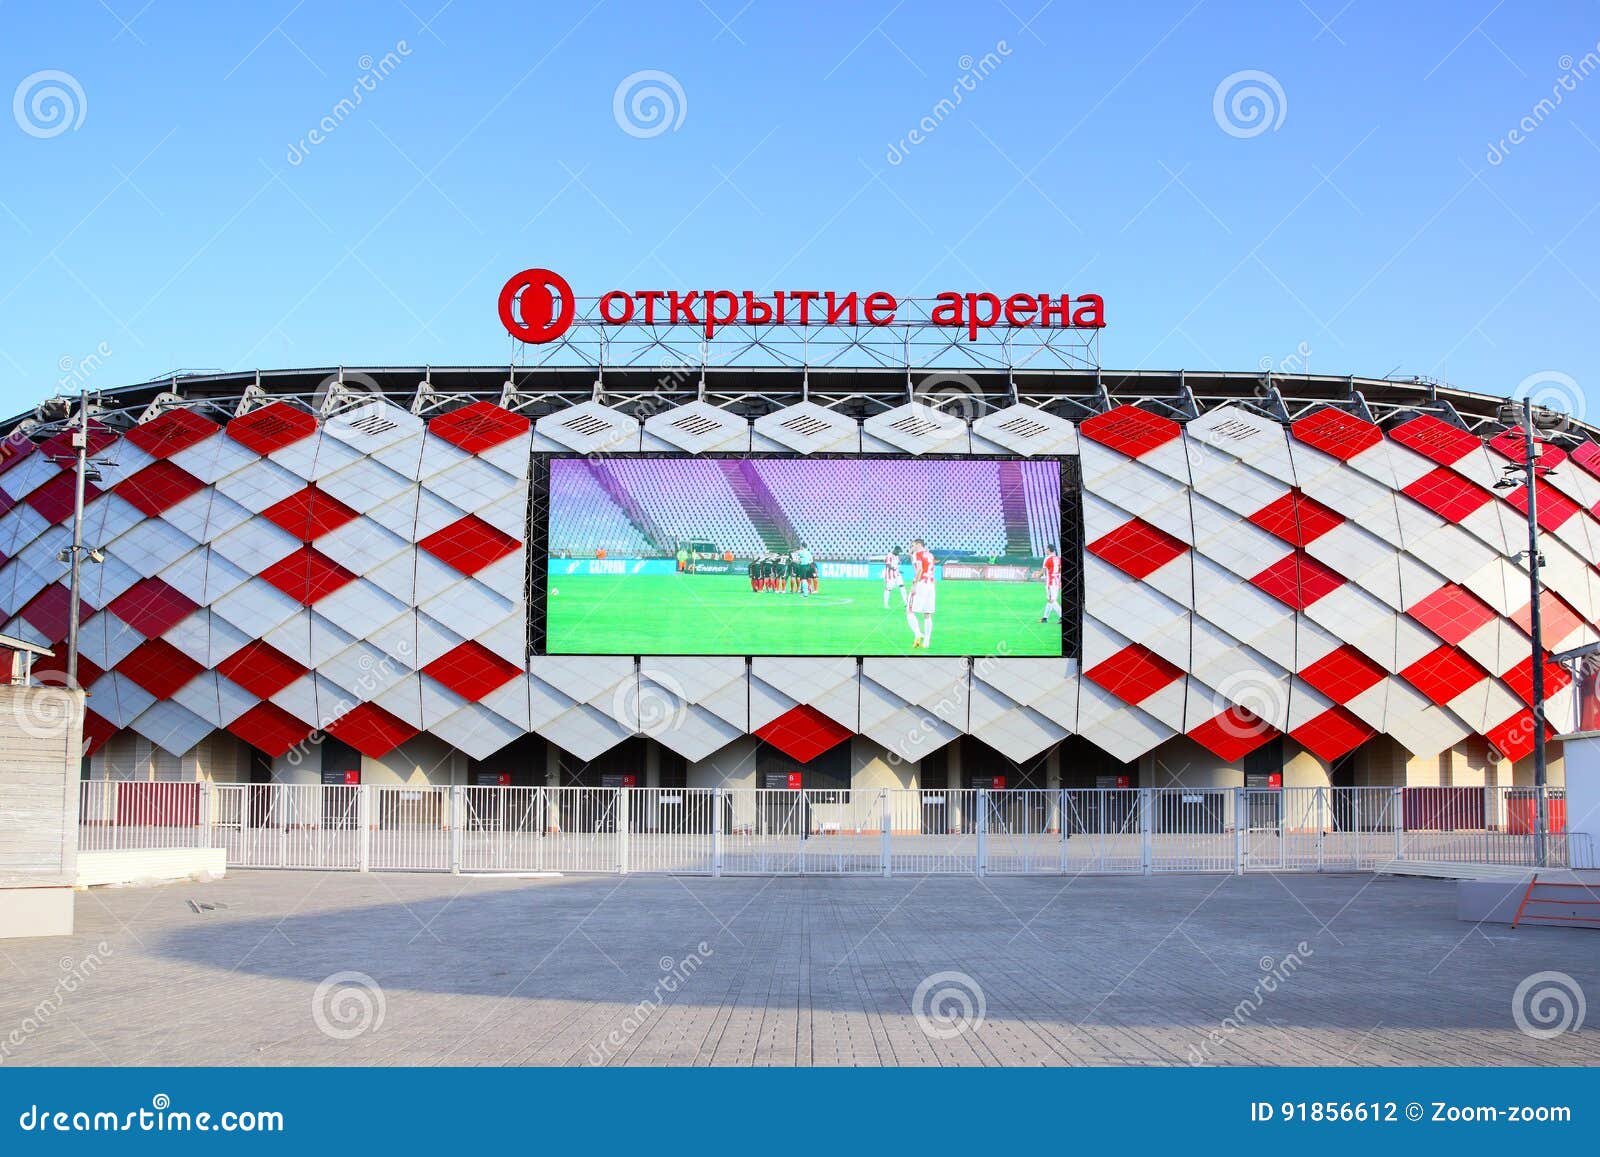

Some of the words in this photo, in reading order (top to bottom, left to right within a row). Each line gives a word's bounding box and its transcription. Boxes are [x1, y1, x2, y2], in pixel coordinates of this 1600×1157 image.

[600, 290, 897, 339] открытие
[931, 291, 1106, 341] арена
[821, 563, 869, 578] GAZPROM
